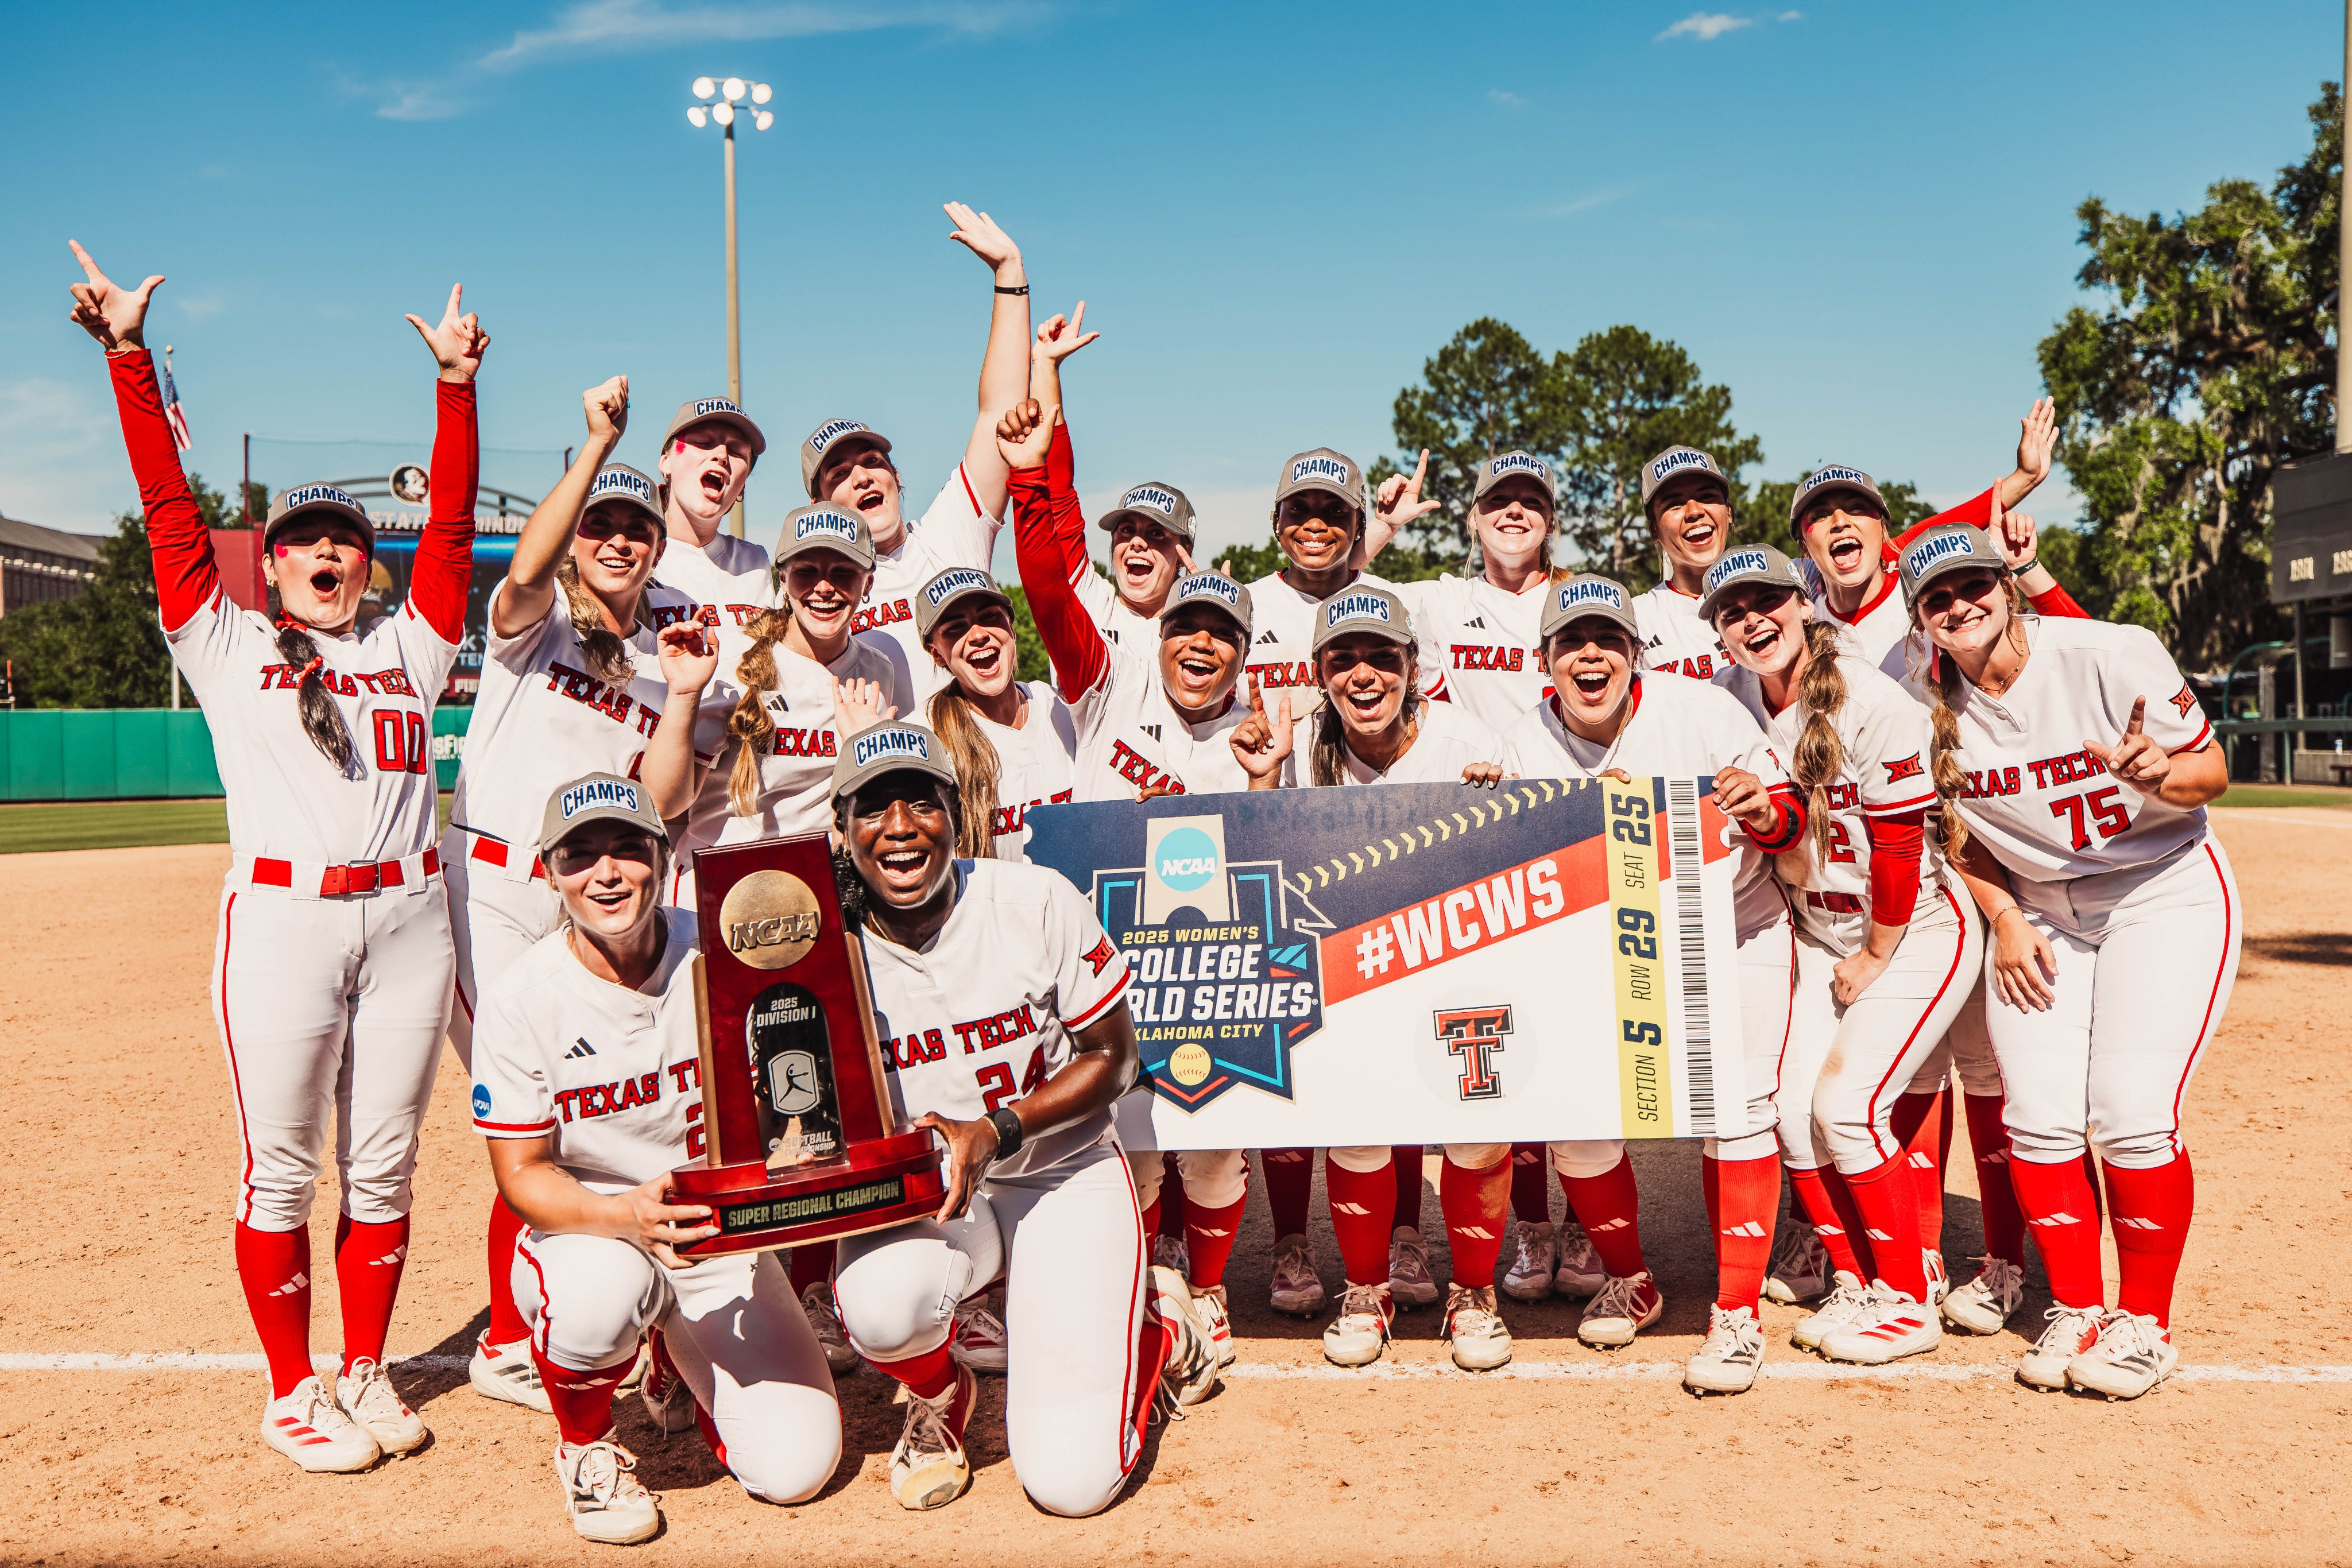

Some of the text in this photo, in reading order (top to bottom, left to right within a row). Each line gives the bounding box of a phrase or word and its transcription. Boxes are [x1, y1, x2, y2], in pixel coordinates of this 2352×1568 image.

[697, 401, 746, 415] CHAMP
[1294, 459, 1346, 483] CHAMPS
[1494, 456, 1544, 478] CHAMPS
[1654, 452, 1708, 479] CHAMPS
[1124, 489, 1174, 513] CHAMPS
[798, 514, 855, 541] CHAMPS
[1910, 535, 1971, 576] CHAMPS
[1929, 552, 1952, 566] 2025
[1710, 553, 1766, 590] CHAMPS
[929, 572, 987, 604] CHAMPS
[1181, 577, 1237, 603] CHAMPS
[1561, 583, 1620, 609] CHAMPS
[651, 604, 763, 633] EXS TE
[850, 598, 912, 636] EXAS
[1329, 597, 1388, 625] CHAMPS
[1450, 644, 1523, 672] TEXAS
[1651, 655, 1713, 680] XAS
[260, 664, 358, 696] TEAS
[353, 668, 419, 698] TEC
[547, 660, 662, 739] TEXAS TE
[372, 709, 427, 775] 00
[759, 727, 837, 757] EXAS
[857, 733, 927, 764] CHAMPS
[1960, 750, 2107, 799] XAS TECH
[564, 783, 636, 816] CHAMPS
[1825, 782, 1860, 810] CH
[2048, 785, 2132, 852] 75
[1161, 857, 1216, 877] NCAA
[733, 912, 818, 951] NCAA
[1356, 858, 1564, 980] #WCWS
[1122, 926, 1259, 944] 2025 WOMEN'S
[1121, 944, 1263, 984] COLLEGE
[1611, 793, 1661, 1121] SECTION 5 ROW 29 SEAT 25
[756, 1006, 816, 1027] DIVISION I
[771, 997, 798, 1011] 2025
[1128, 986, 1186, 1023] RLD
[879, 1004, 1038, 1073] XAS TECH
[1134, 1024, 1264, 1042] KLAHOMA CITY
[976, 1043, 1049, 1116] 24
[555, 1072, 660, 1124] TEXAS
[729, 1181, 899, 1227] SUPER REGIONAL CHAMPION
